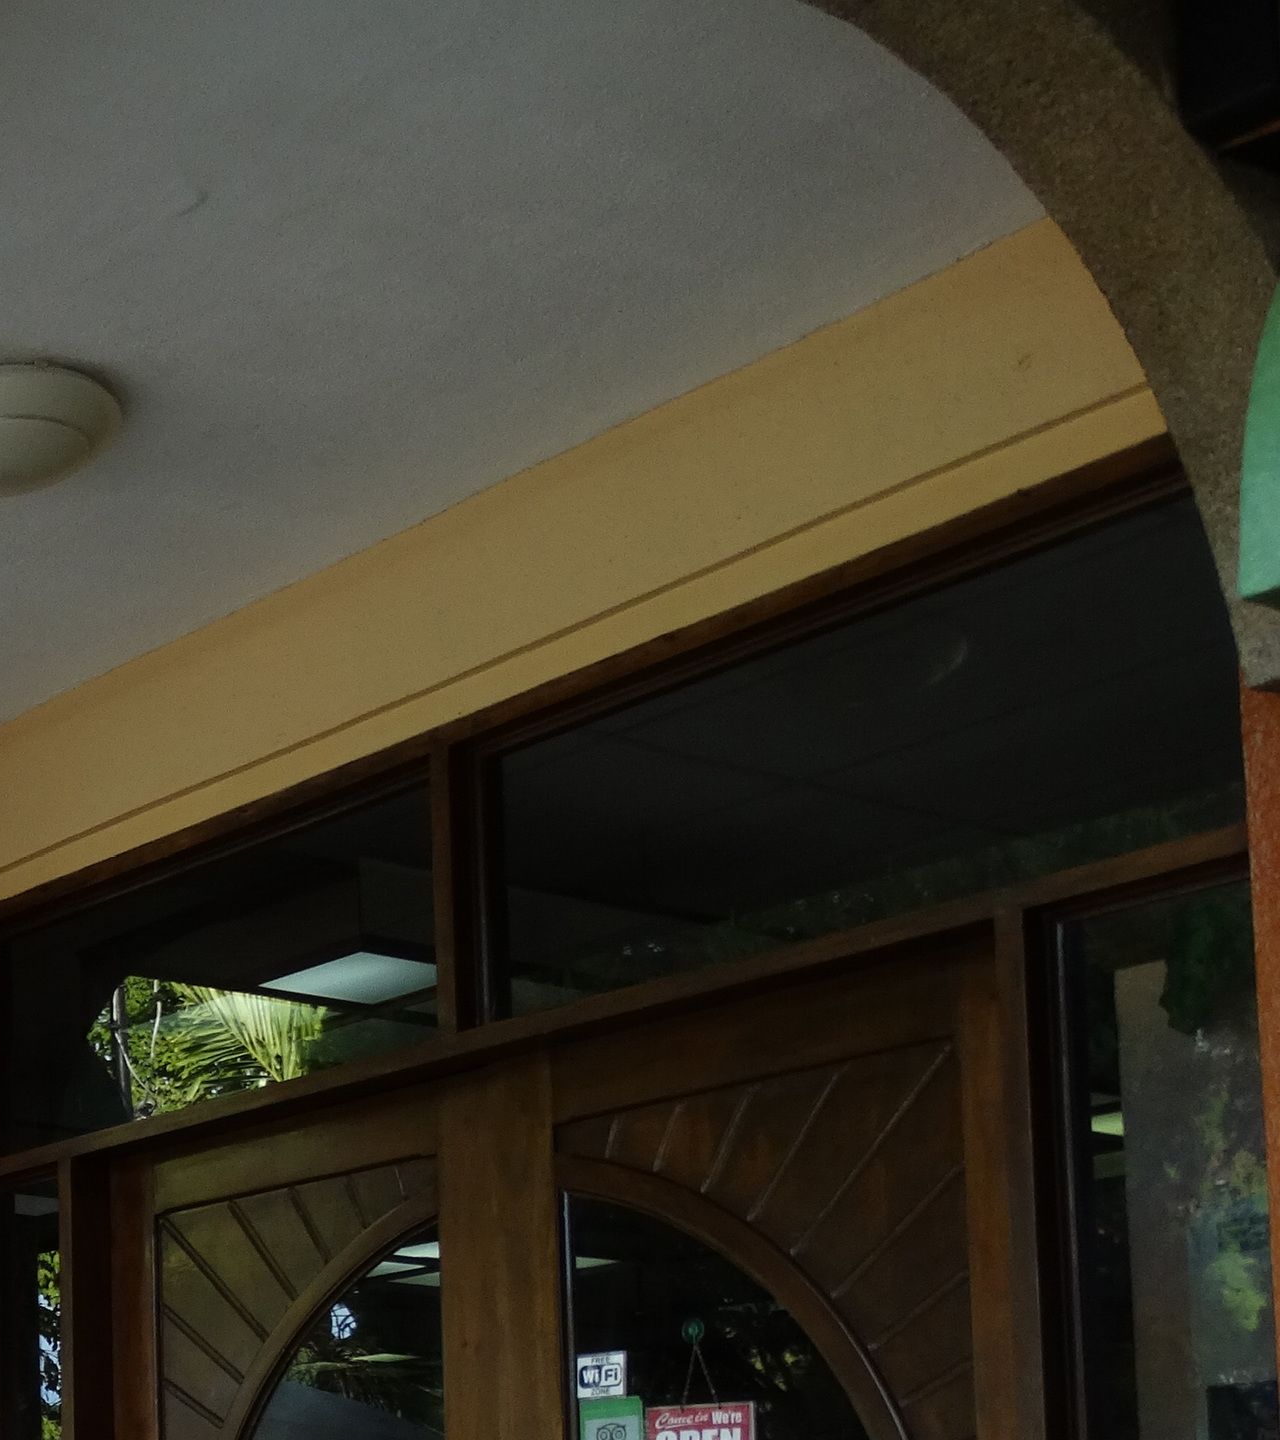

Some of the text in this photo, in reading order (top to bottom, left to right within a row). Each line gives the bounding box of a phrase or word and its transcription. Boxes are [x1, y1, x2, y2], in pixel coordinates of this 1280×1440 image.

[591, 1388, 610, 1396] ZONE
[655, 1411, 742, 1429] Come in We're
